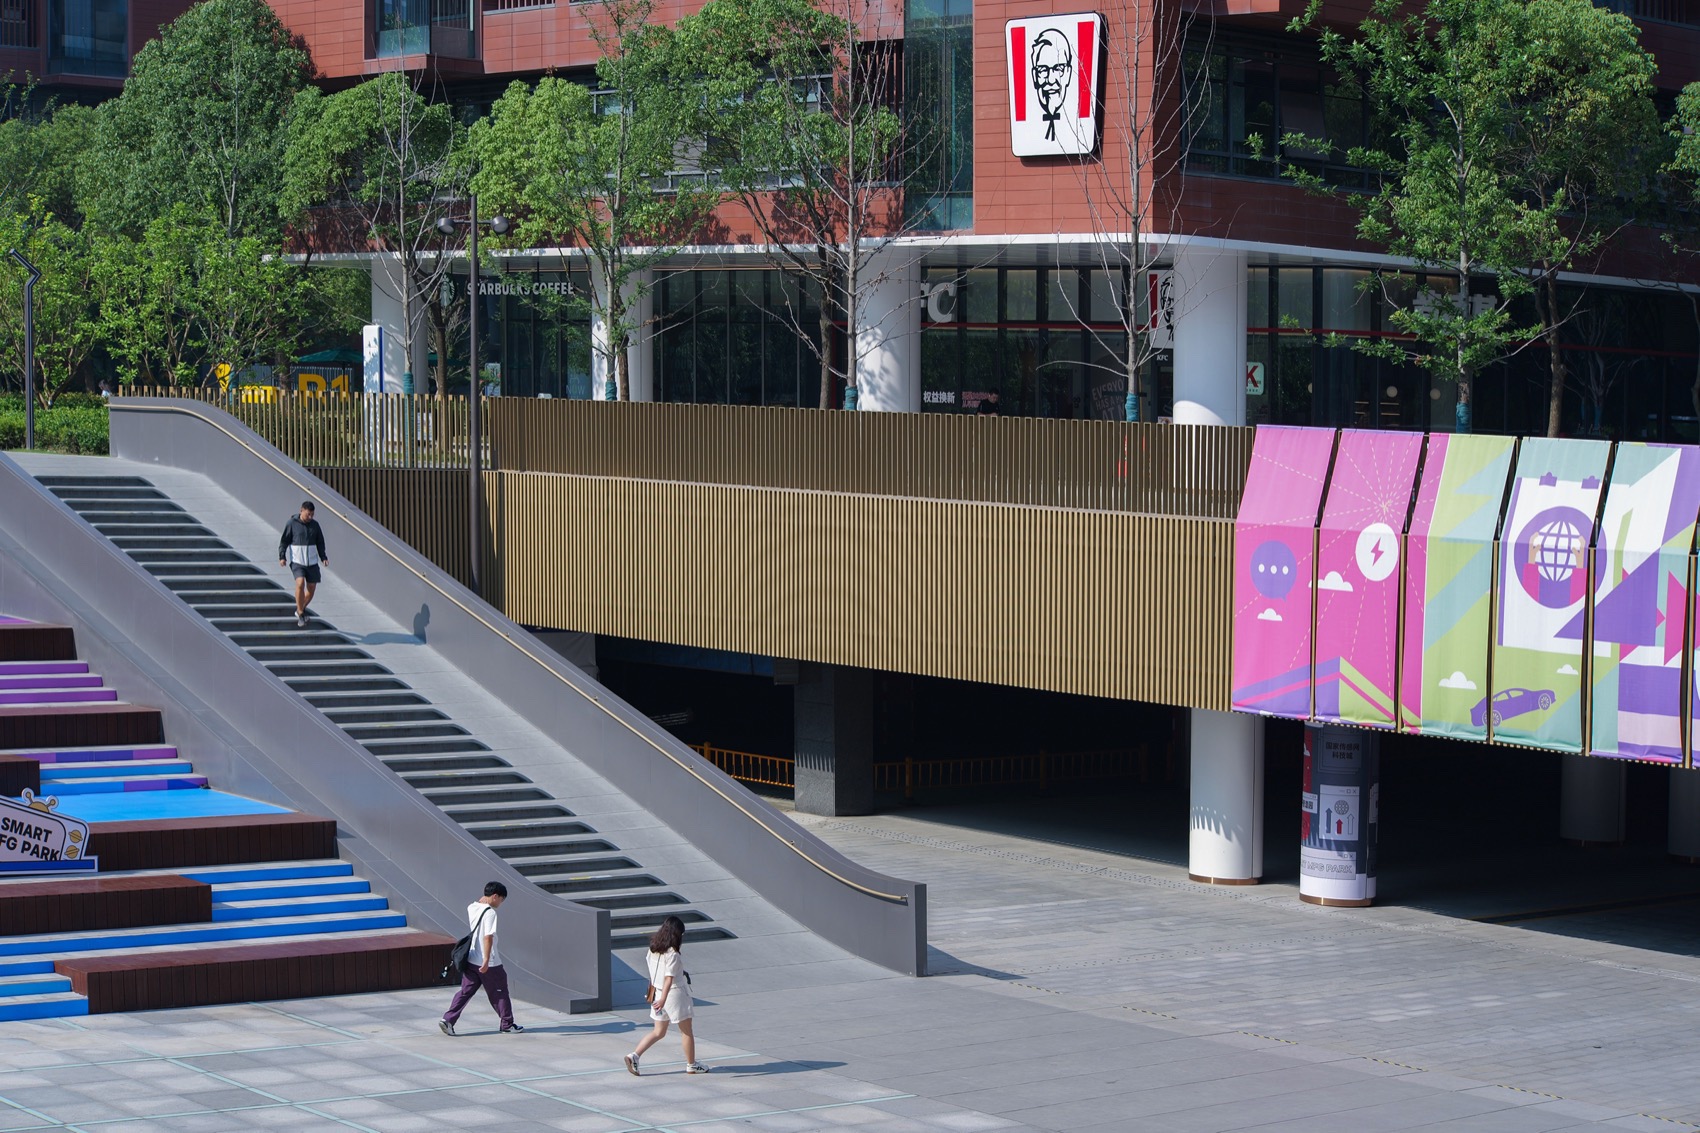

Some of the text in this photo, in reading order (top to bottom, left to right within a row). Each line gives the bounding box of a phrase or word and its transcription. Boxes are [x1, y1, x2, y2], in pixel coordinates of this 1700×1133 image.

[1, 817, 52, 842] SMART
[21, 840, 60, 860] PARK
[1326, 864, 1352, 873] PARK
